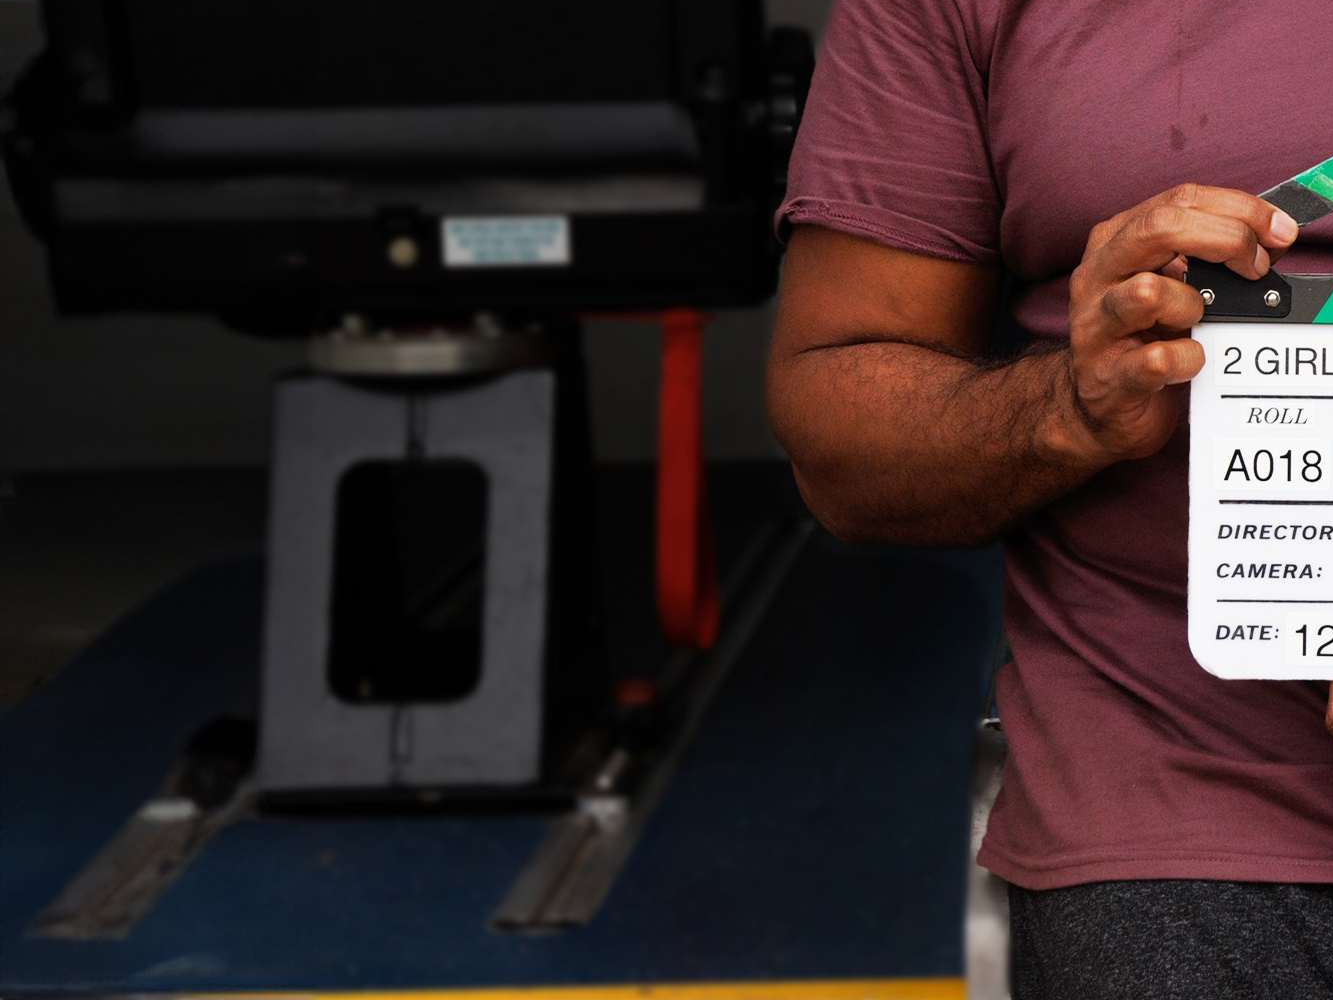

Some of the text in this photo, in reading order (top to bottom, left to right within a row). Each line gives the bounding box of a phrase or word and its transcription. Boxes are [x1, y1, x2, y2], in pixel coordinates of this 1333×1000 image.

[1224, 347, 1241, 374] 2
[1247, 408, 1307, 424] ROLL
[1224, 449, 1322, 482] A018
[1217, 563, 1322, 579] CAMERA:
[1216, 625, 1279, 640] DATE:
